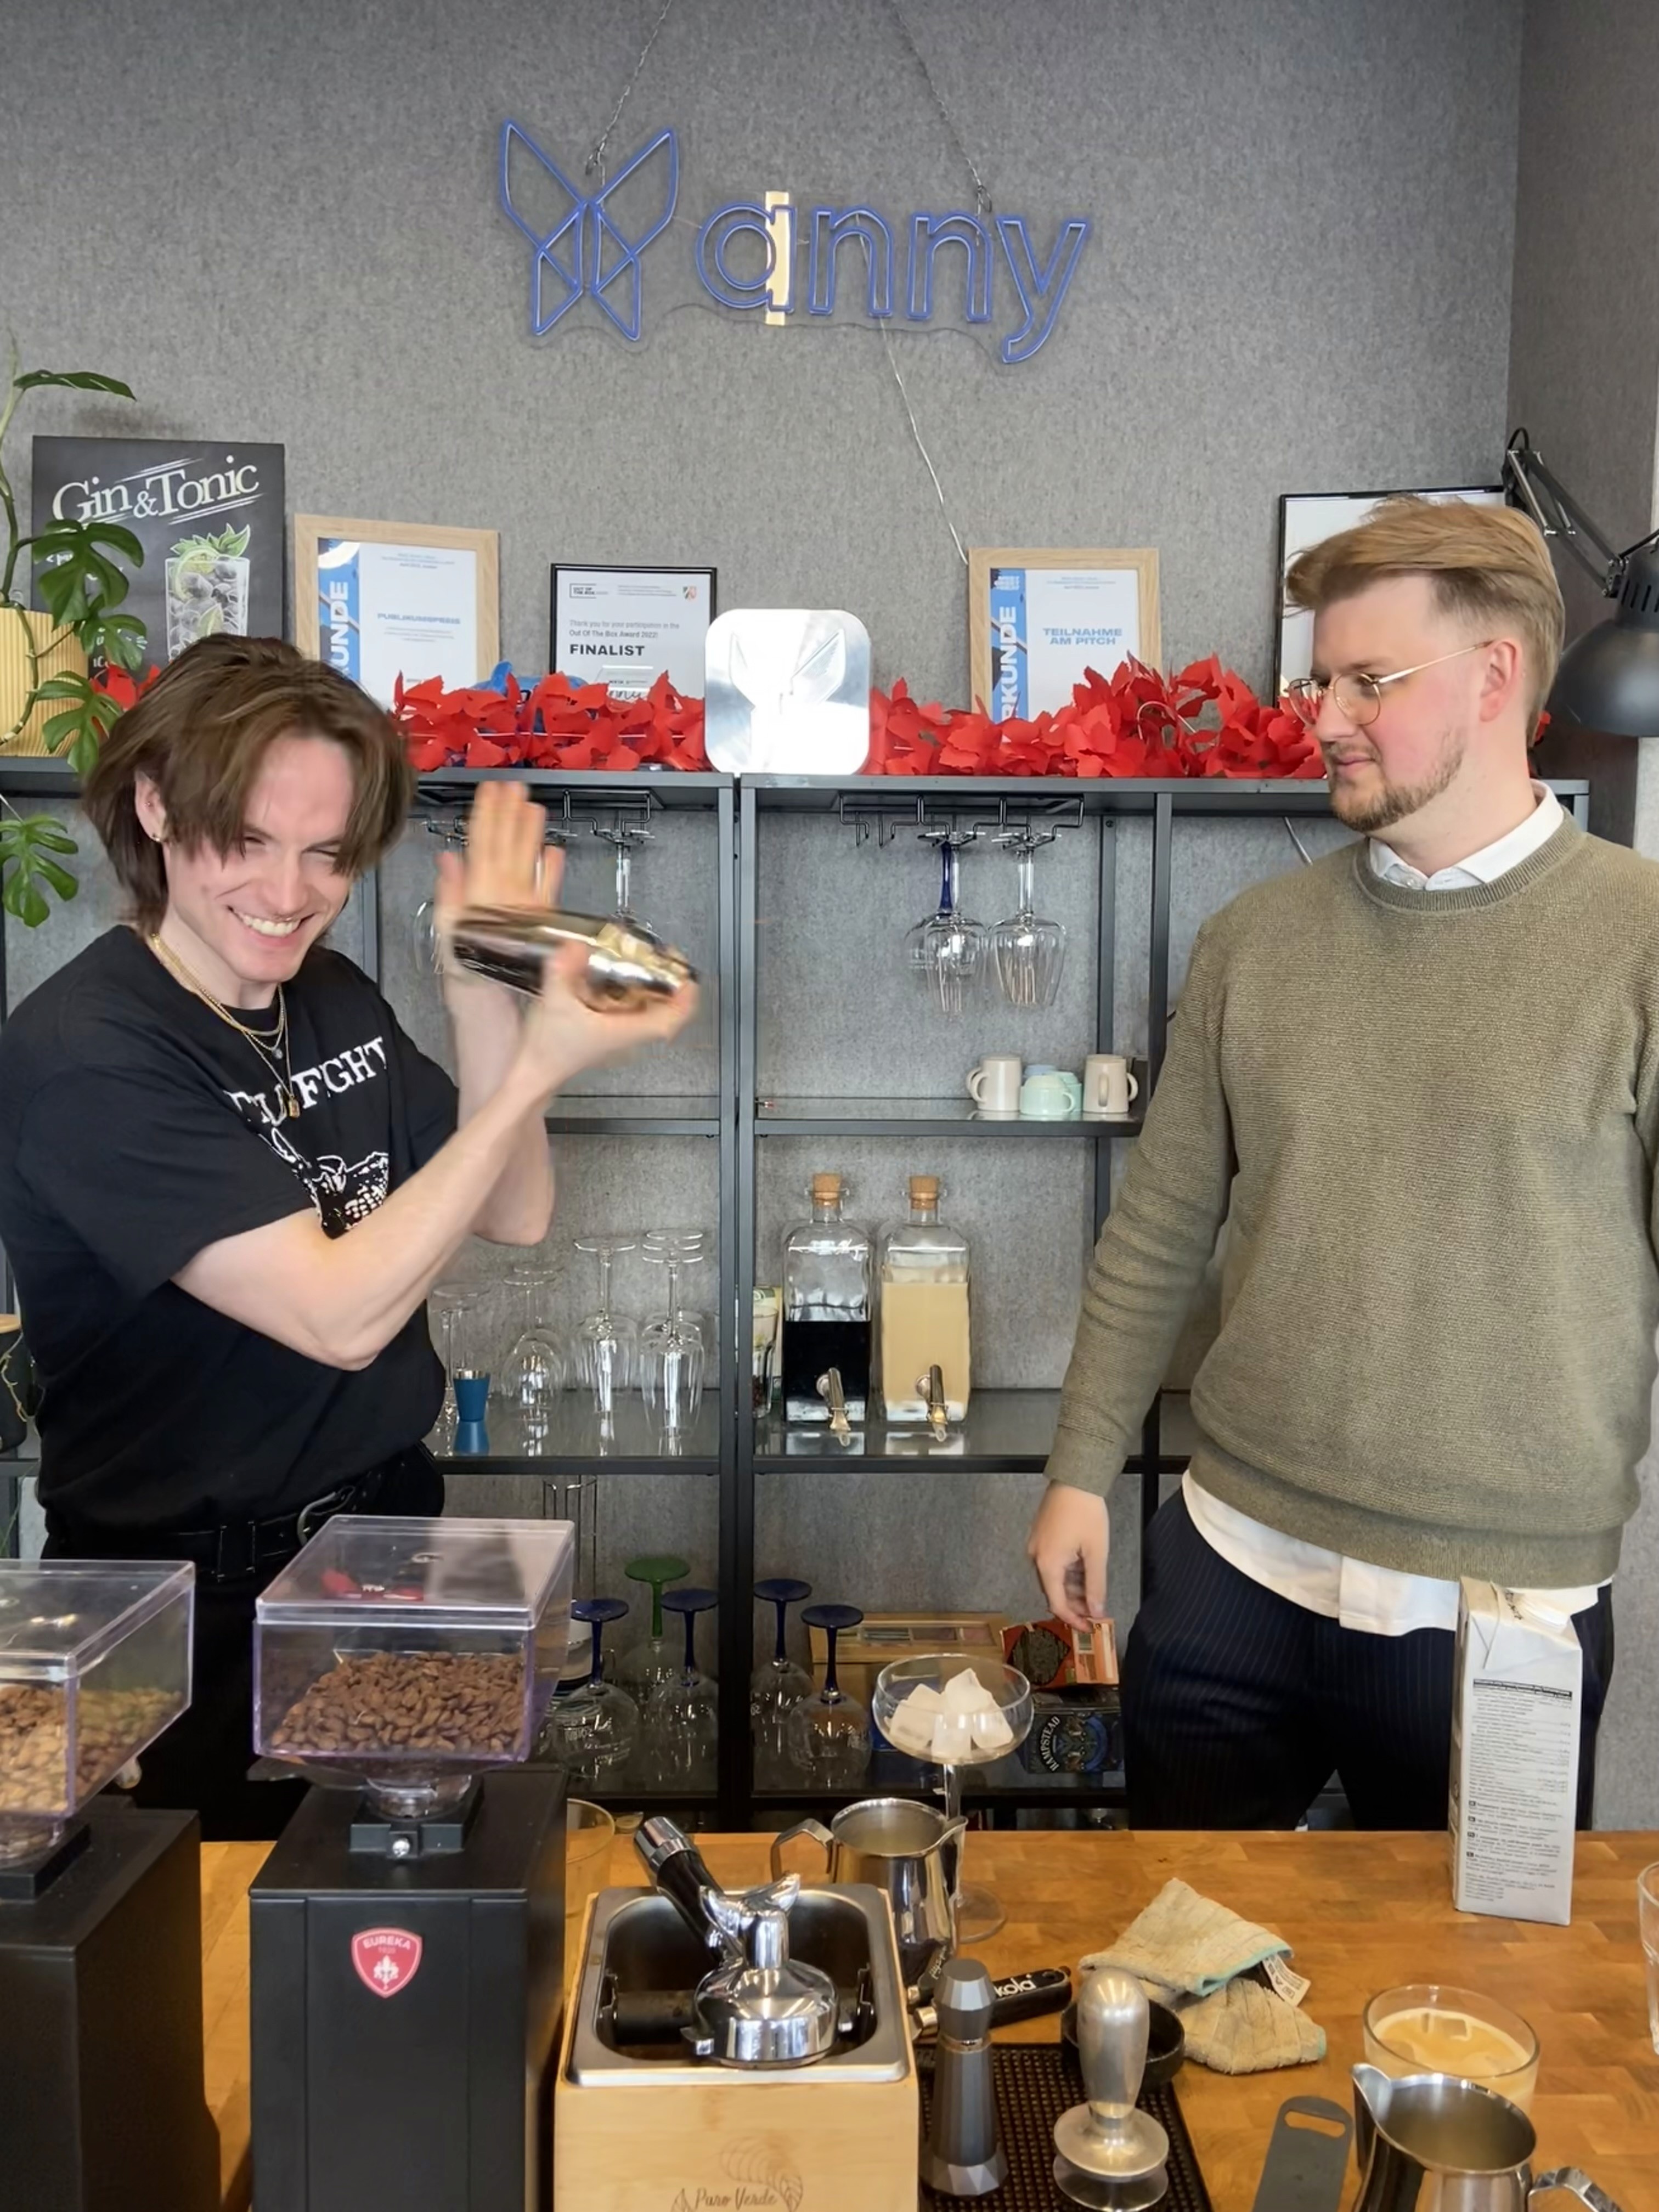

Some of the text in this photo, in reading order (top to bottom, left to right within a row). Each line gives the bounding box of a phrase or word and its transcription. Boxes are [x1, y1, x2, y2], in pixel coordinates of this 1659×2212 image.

[696, 201, 1092, 364] anny
[52, 477, 133, 523] Gin
[145, 455, 259, 517] Tonic
[1043, 628, 1122, 636] TEILNAHME
[570, 644, 645, 656] FINALIST
[1040, 1715, 1060, 1771] HAMPSTEAD
[363, 1935, 410, 1950] EUREKA
[695, 2186, 778, 2211] Puro Verde
